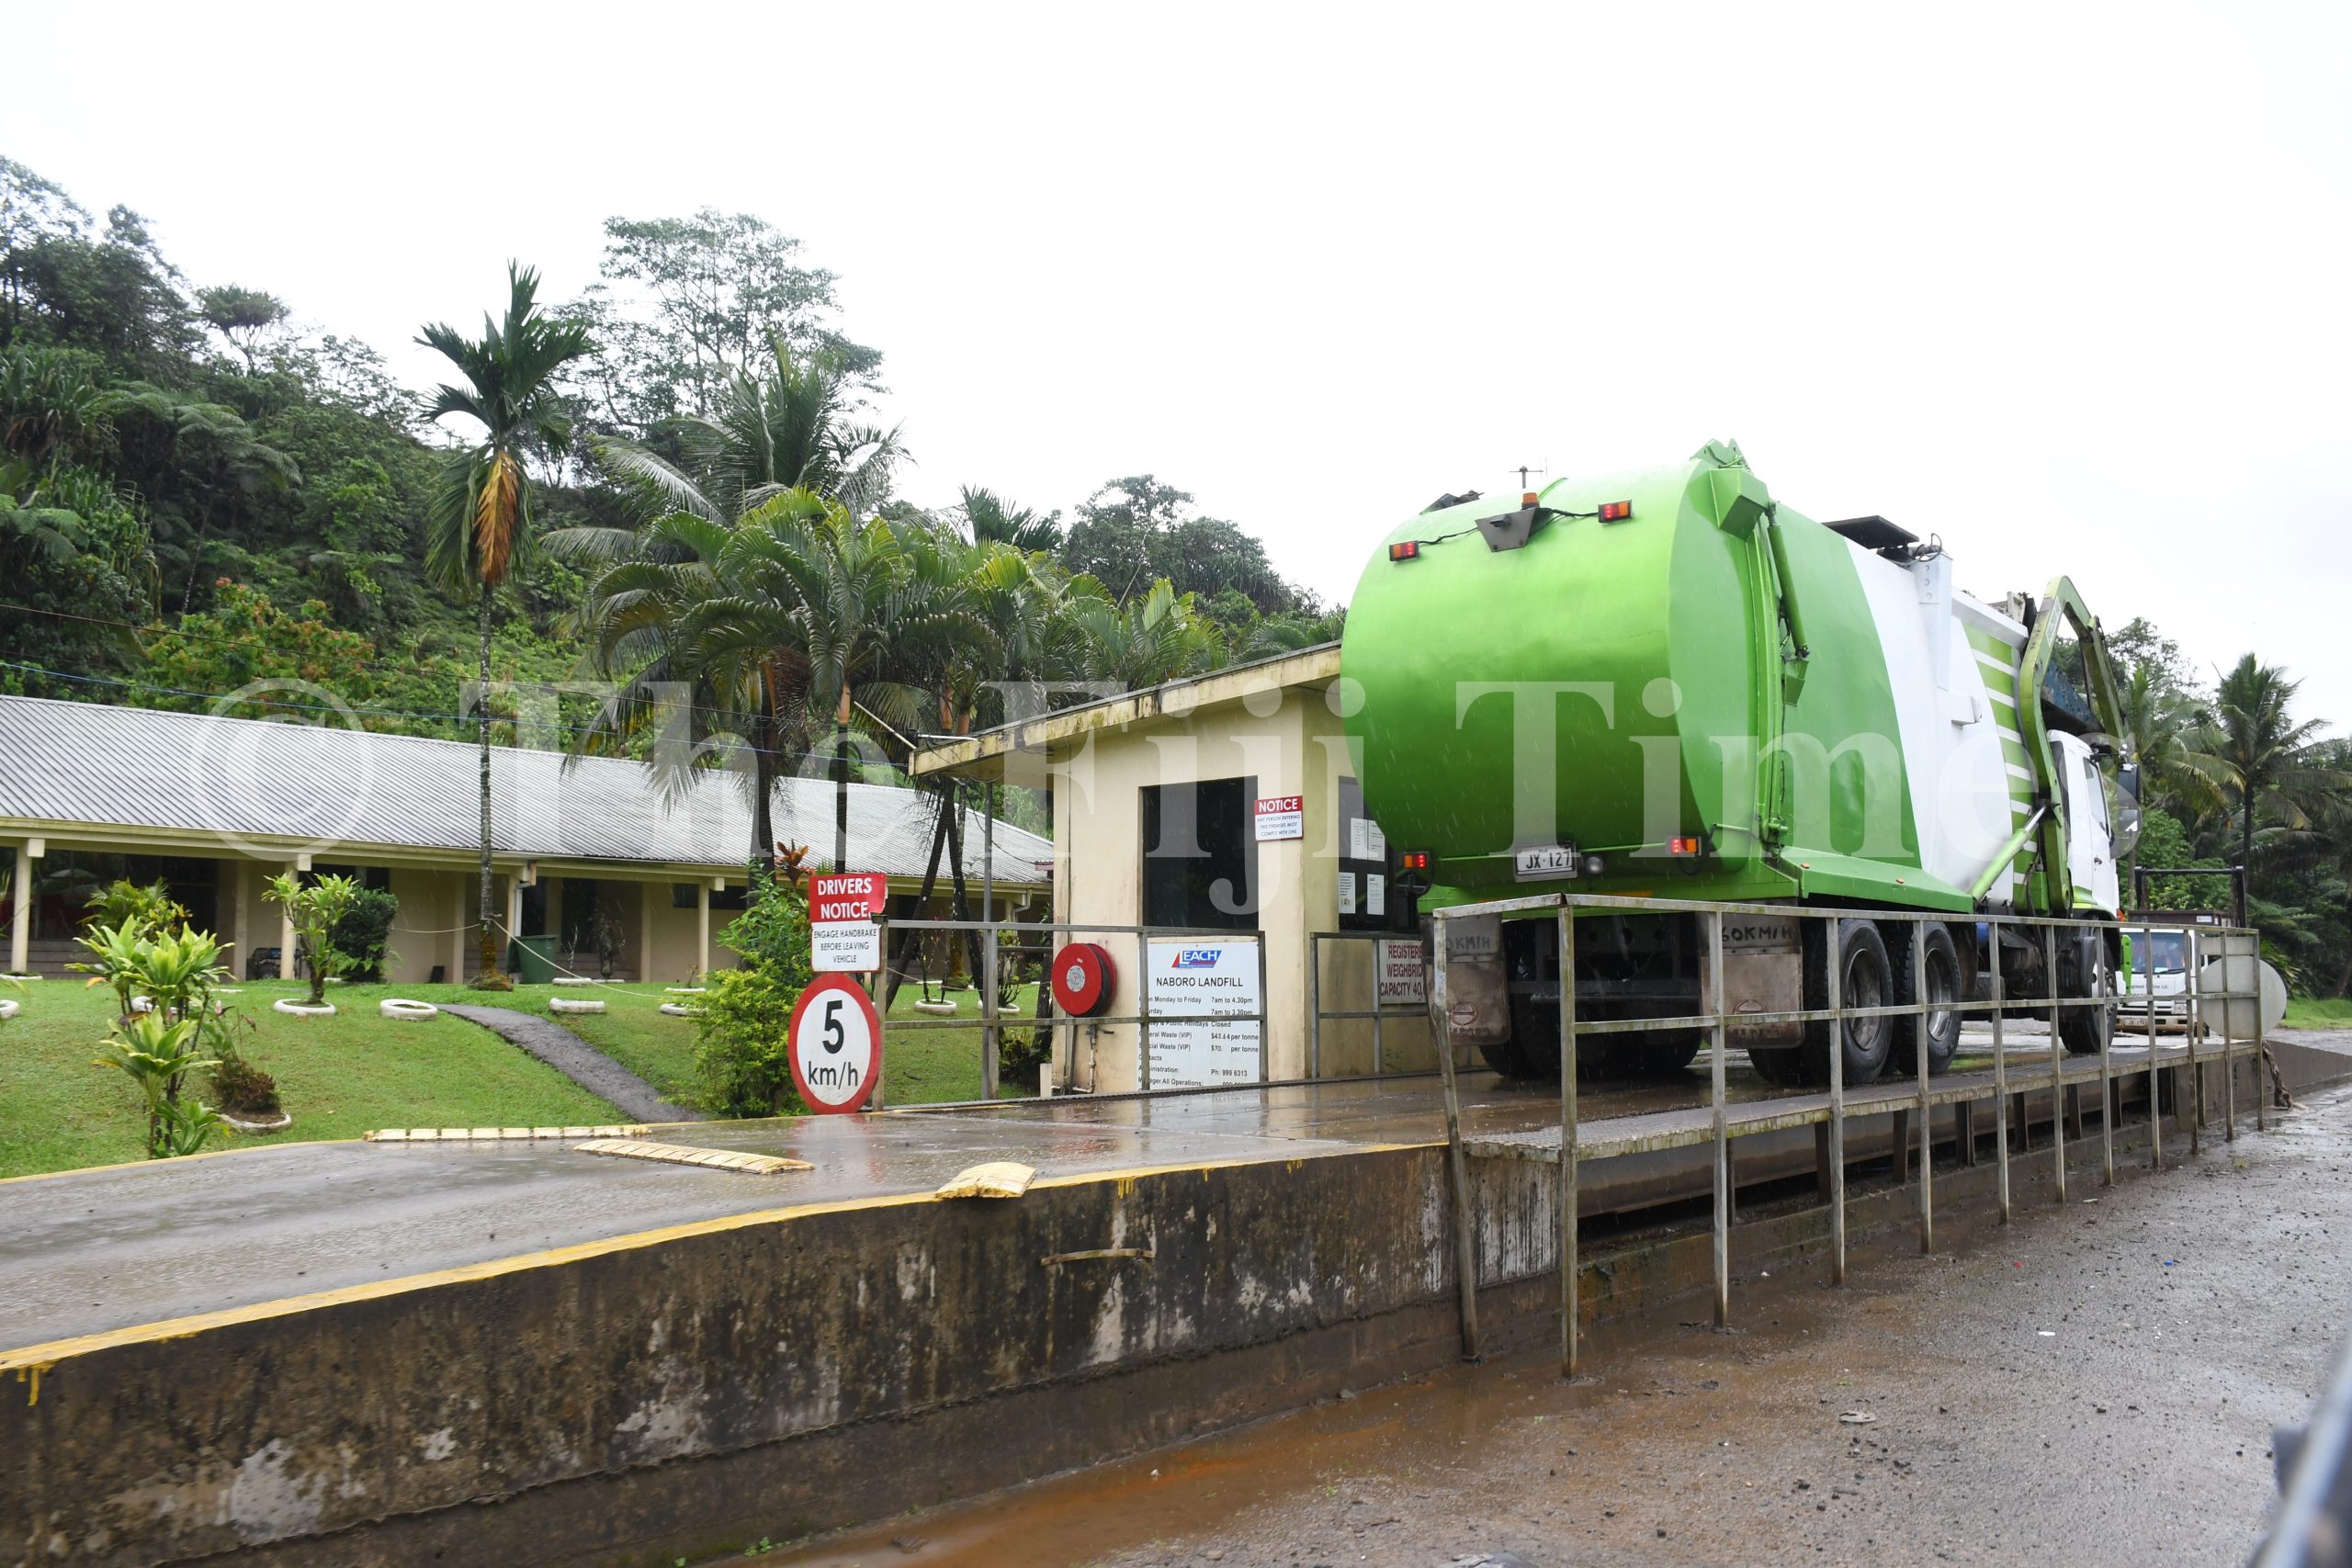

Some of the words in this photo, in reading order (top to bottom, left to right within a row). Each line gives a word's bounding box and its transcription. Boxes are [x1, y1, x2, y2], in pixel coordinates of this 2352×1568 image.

[1259, 798, 1297, 812] NOTICE
[818, 877, 872, 896] DRIVERS
[814, 930, 839, 938] ENGAGE
[840, 928, 877, 938] HANDBRAKE
[820, 942, 841, 951] BEFORE
[843, 942, 869, 950] LEAVING
[1388, 945, 1423, 959] REGISTERE
[833, 955, 857, 963] VEHICLE
[1179, 950, 1217, 964] LEACH
[1386, 963, 1424, 978] WEIGHBRID
[1156, 977, 1196, 987] NABORO
[1198, 977, 1243, 987] LANDFILL
[1380, 982, 1411, 996] CAPACITY
[822, 999, 844, 1055] 5
[808, 1060, 858, 1090] km/h
